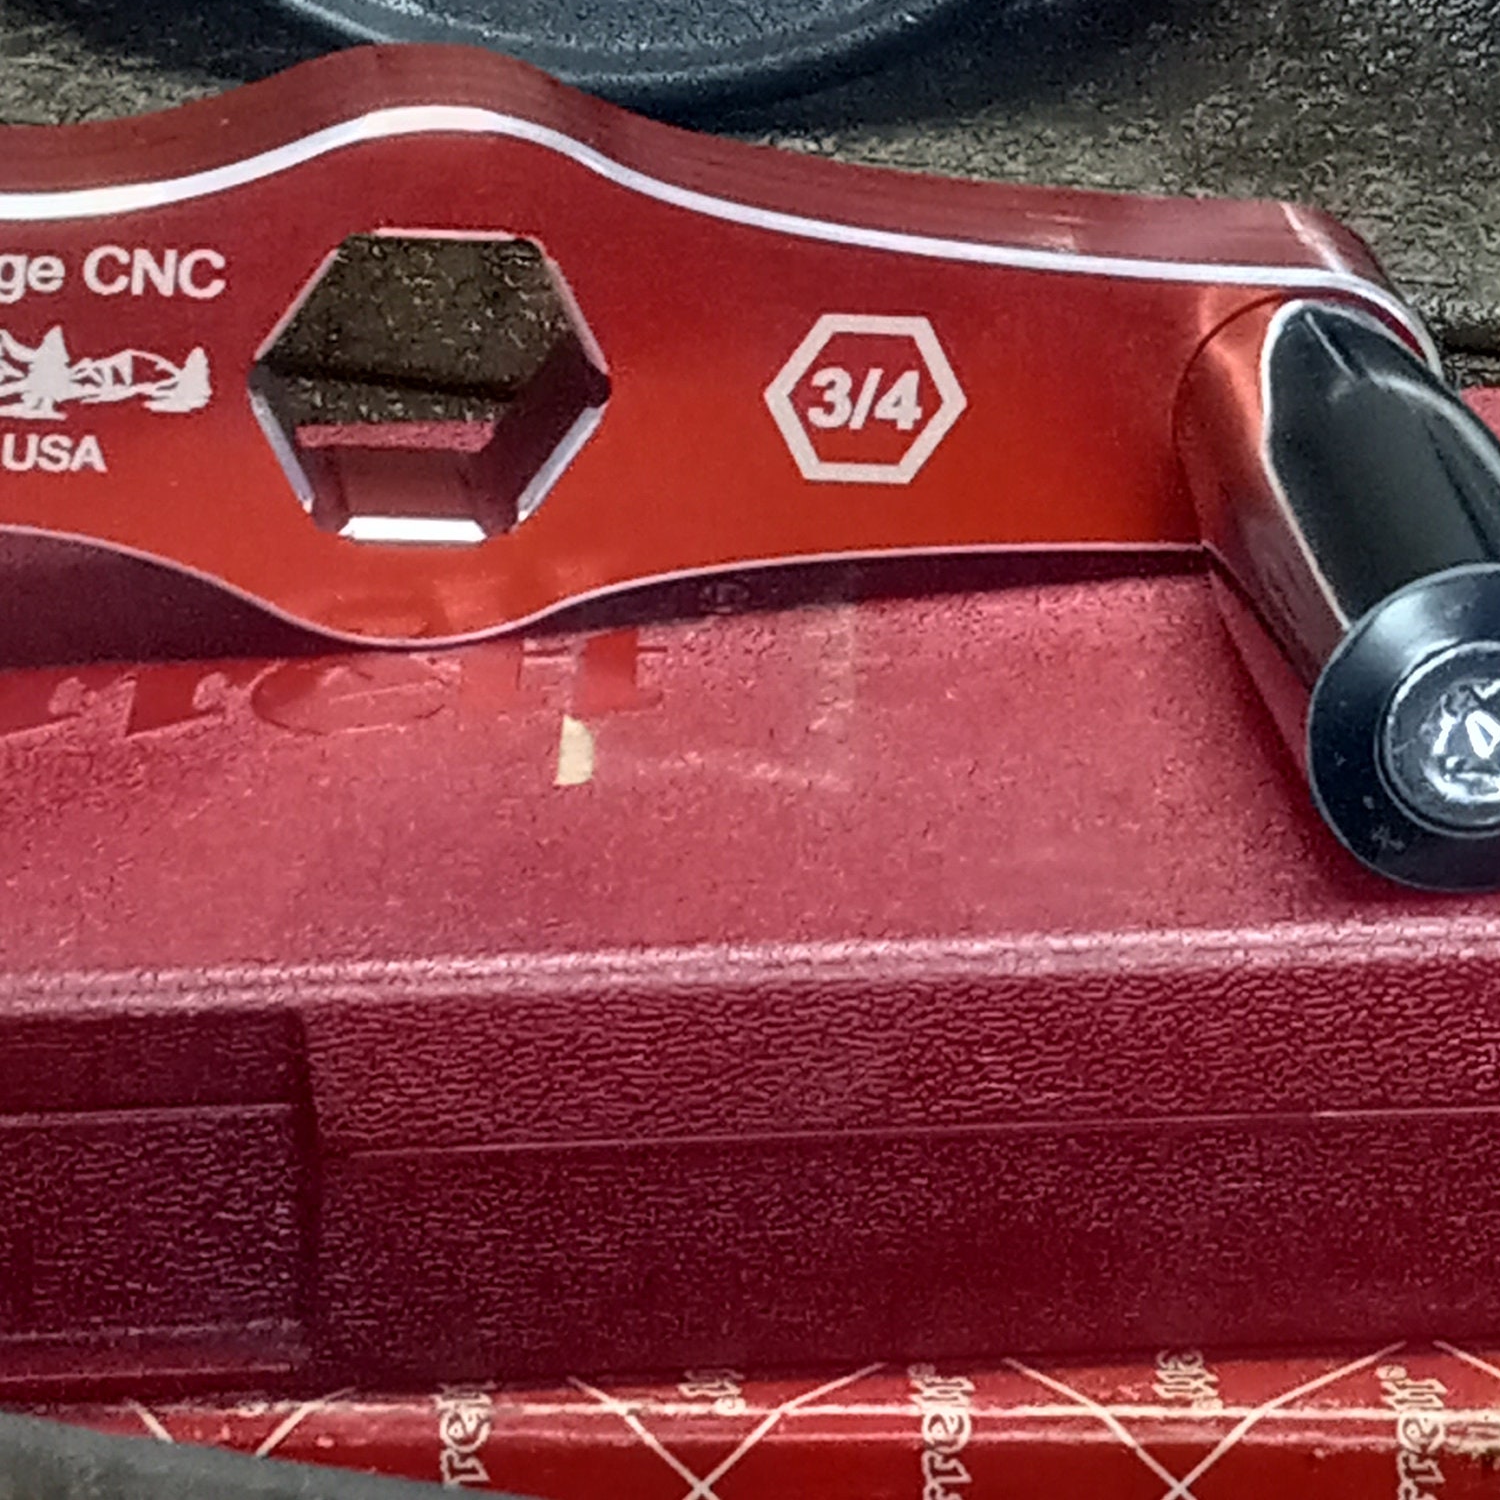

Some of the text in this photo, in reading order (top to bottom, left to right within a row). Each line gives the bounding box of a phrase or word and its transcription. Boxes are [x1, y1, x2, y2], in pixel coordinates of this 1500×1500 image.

[83, 245, 226, 298] CNC
[807, 367, 923, 430] 3/4
[1, 433, 108, 473] USA
